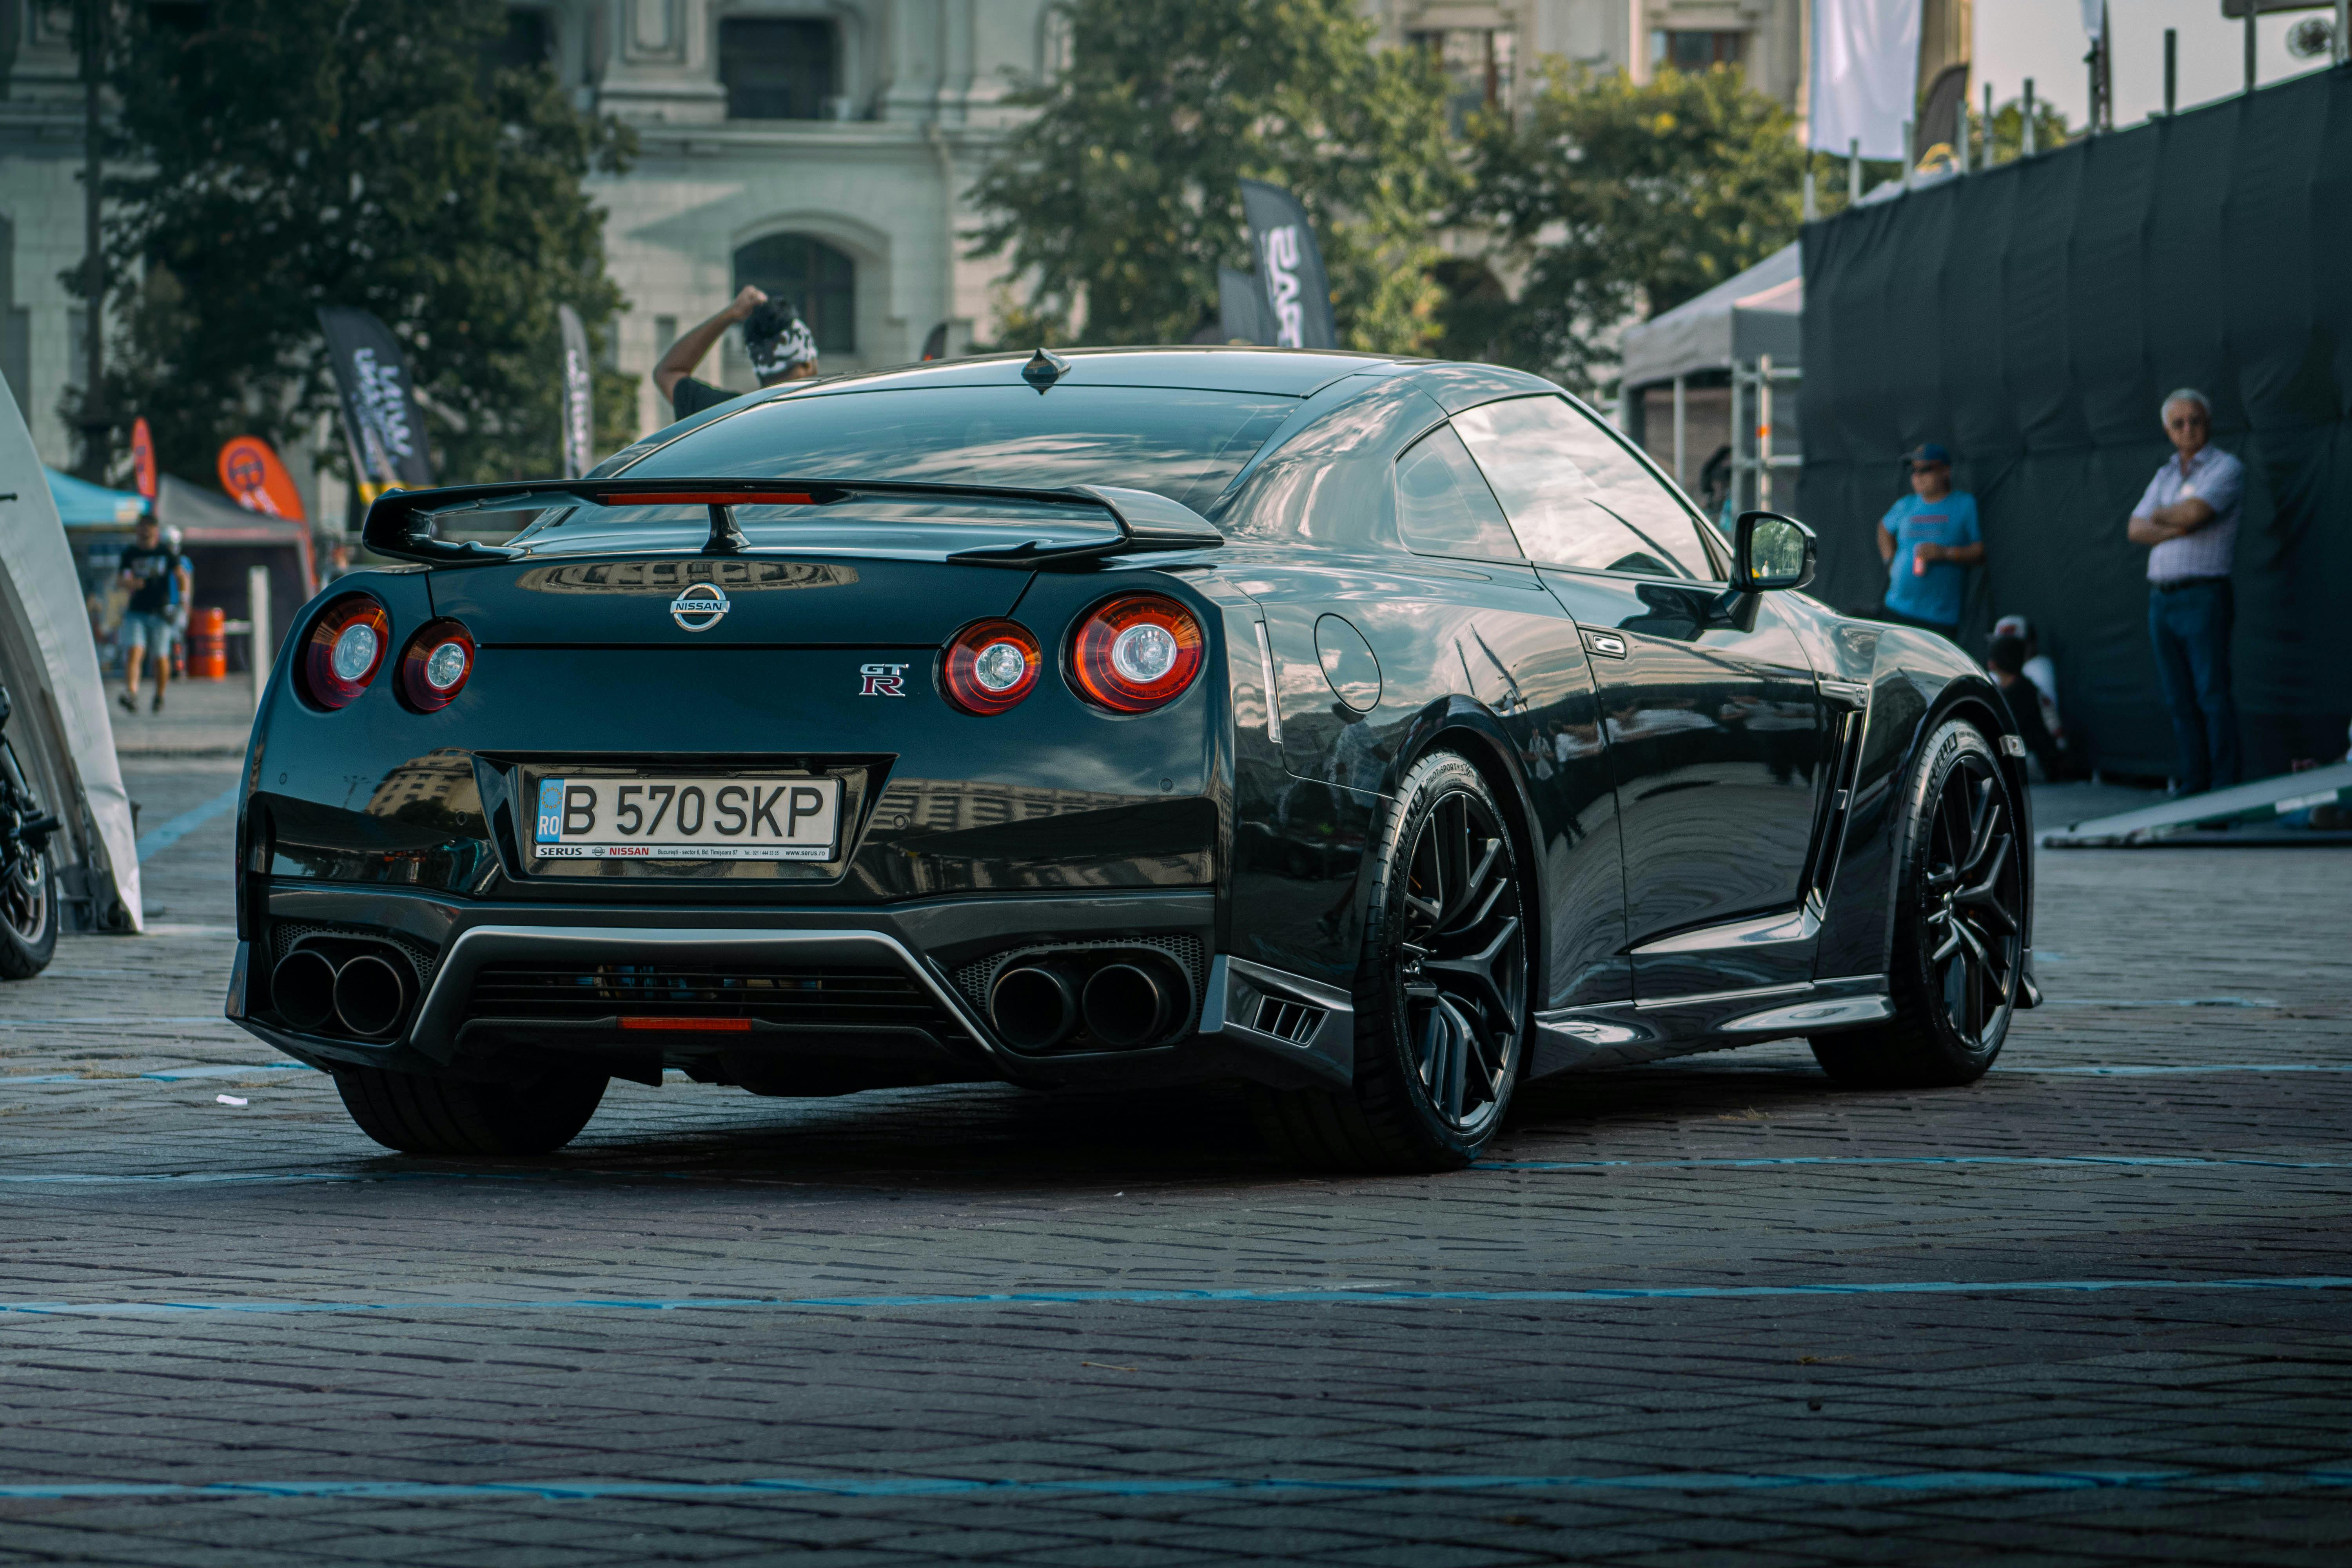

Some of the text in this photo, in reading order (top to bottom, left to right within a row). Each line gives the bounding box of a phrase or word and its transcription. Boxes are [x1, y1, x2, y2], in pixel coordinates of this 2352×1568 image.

[1426, 768, 1439, 786] PILOT
[1440, 763, 1456, 774] SPORT
[563, 785, 824, 837] B 570 SKP
[539, 815, 559, 835] RO
[540, 848, 583, 856] SERUS
[609, 847, 649, 855] NISSAN
